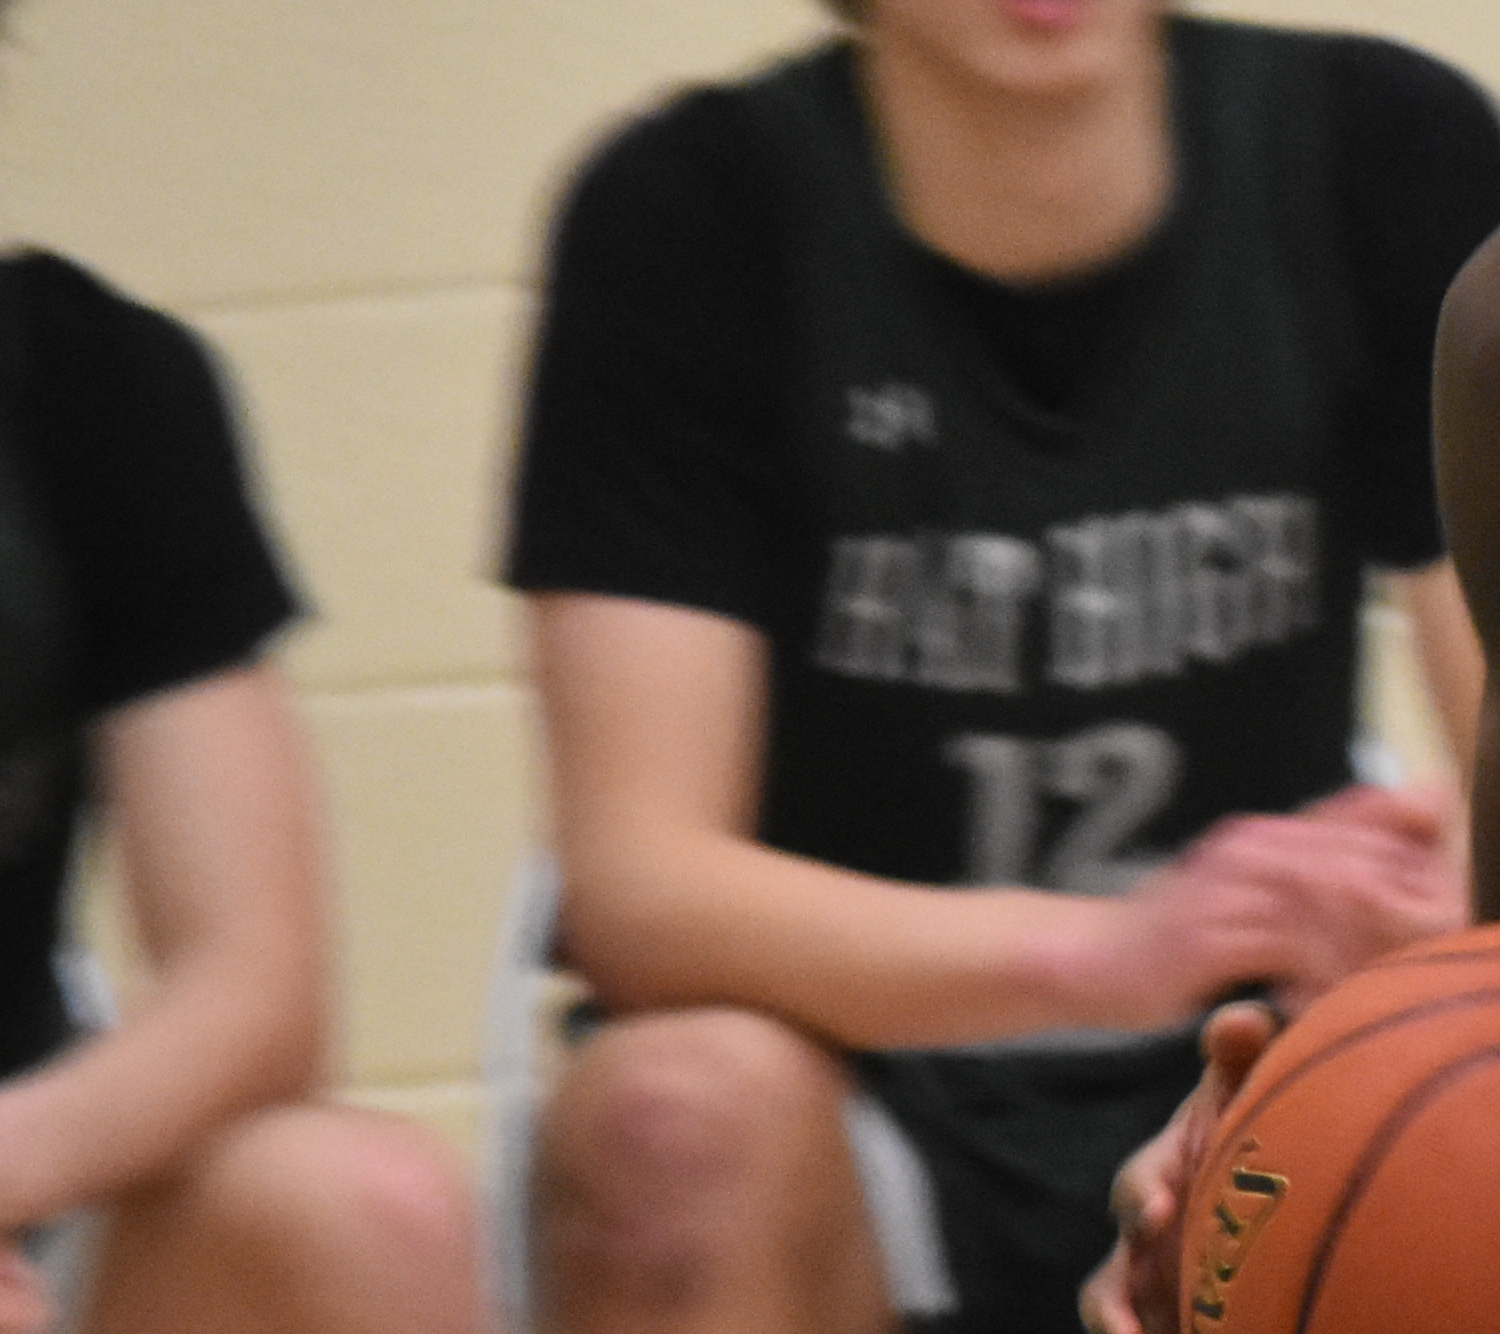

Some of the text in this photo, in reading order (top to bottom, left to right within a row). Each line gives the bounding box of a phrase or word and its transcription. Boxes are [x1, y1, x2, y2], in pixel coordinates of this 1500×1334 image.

[818, 491, 1320, 693] HAT HIGH
[940, 721, 1190, 897] 12
